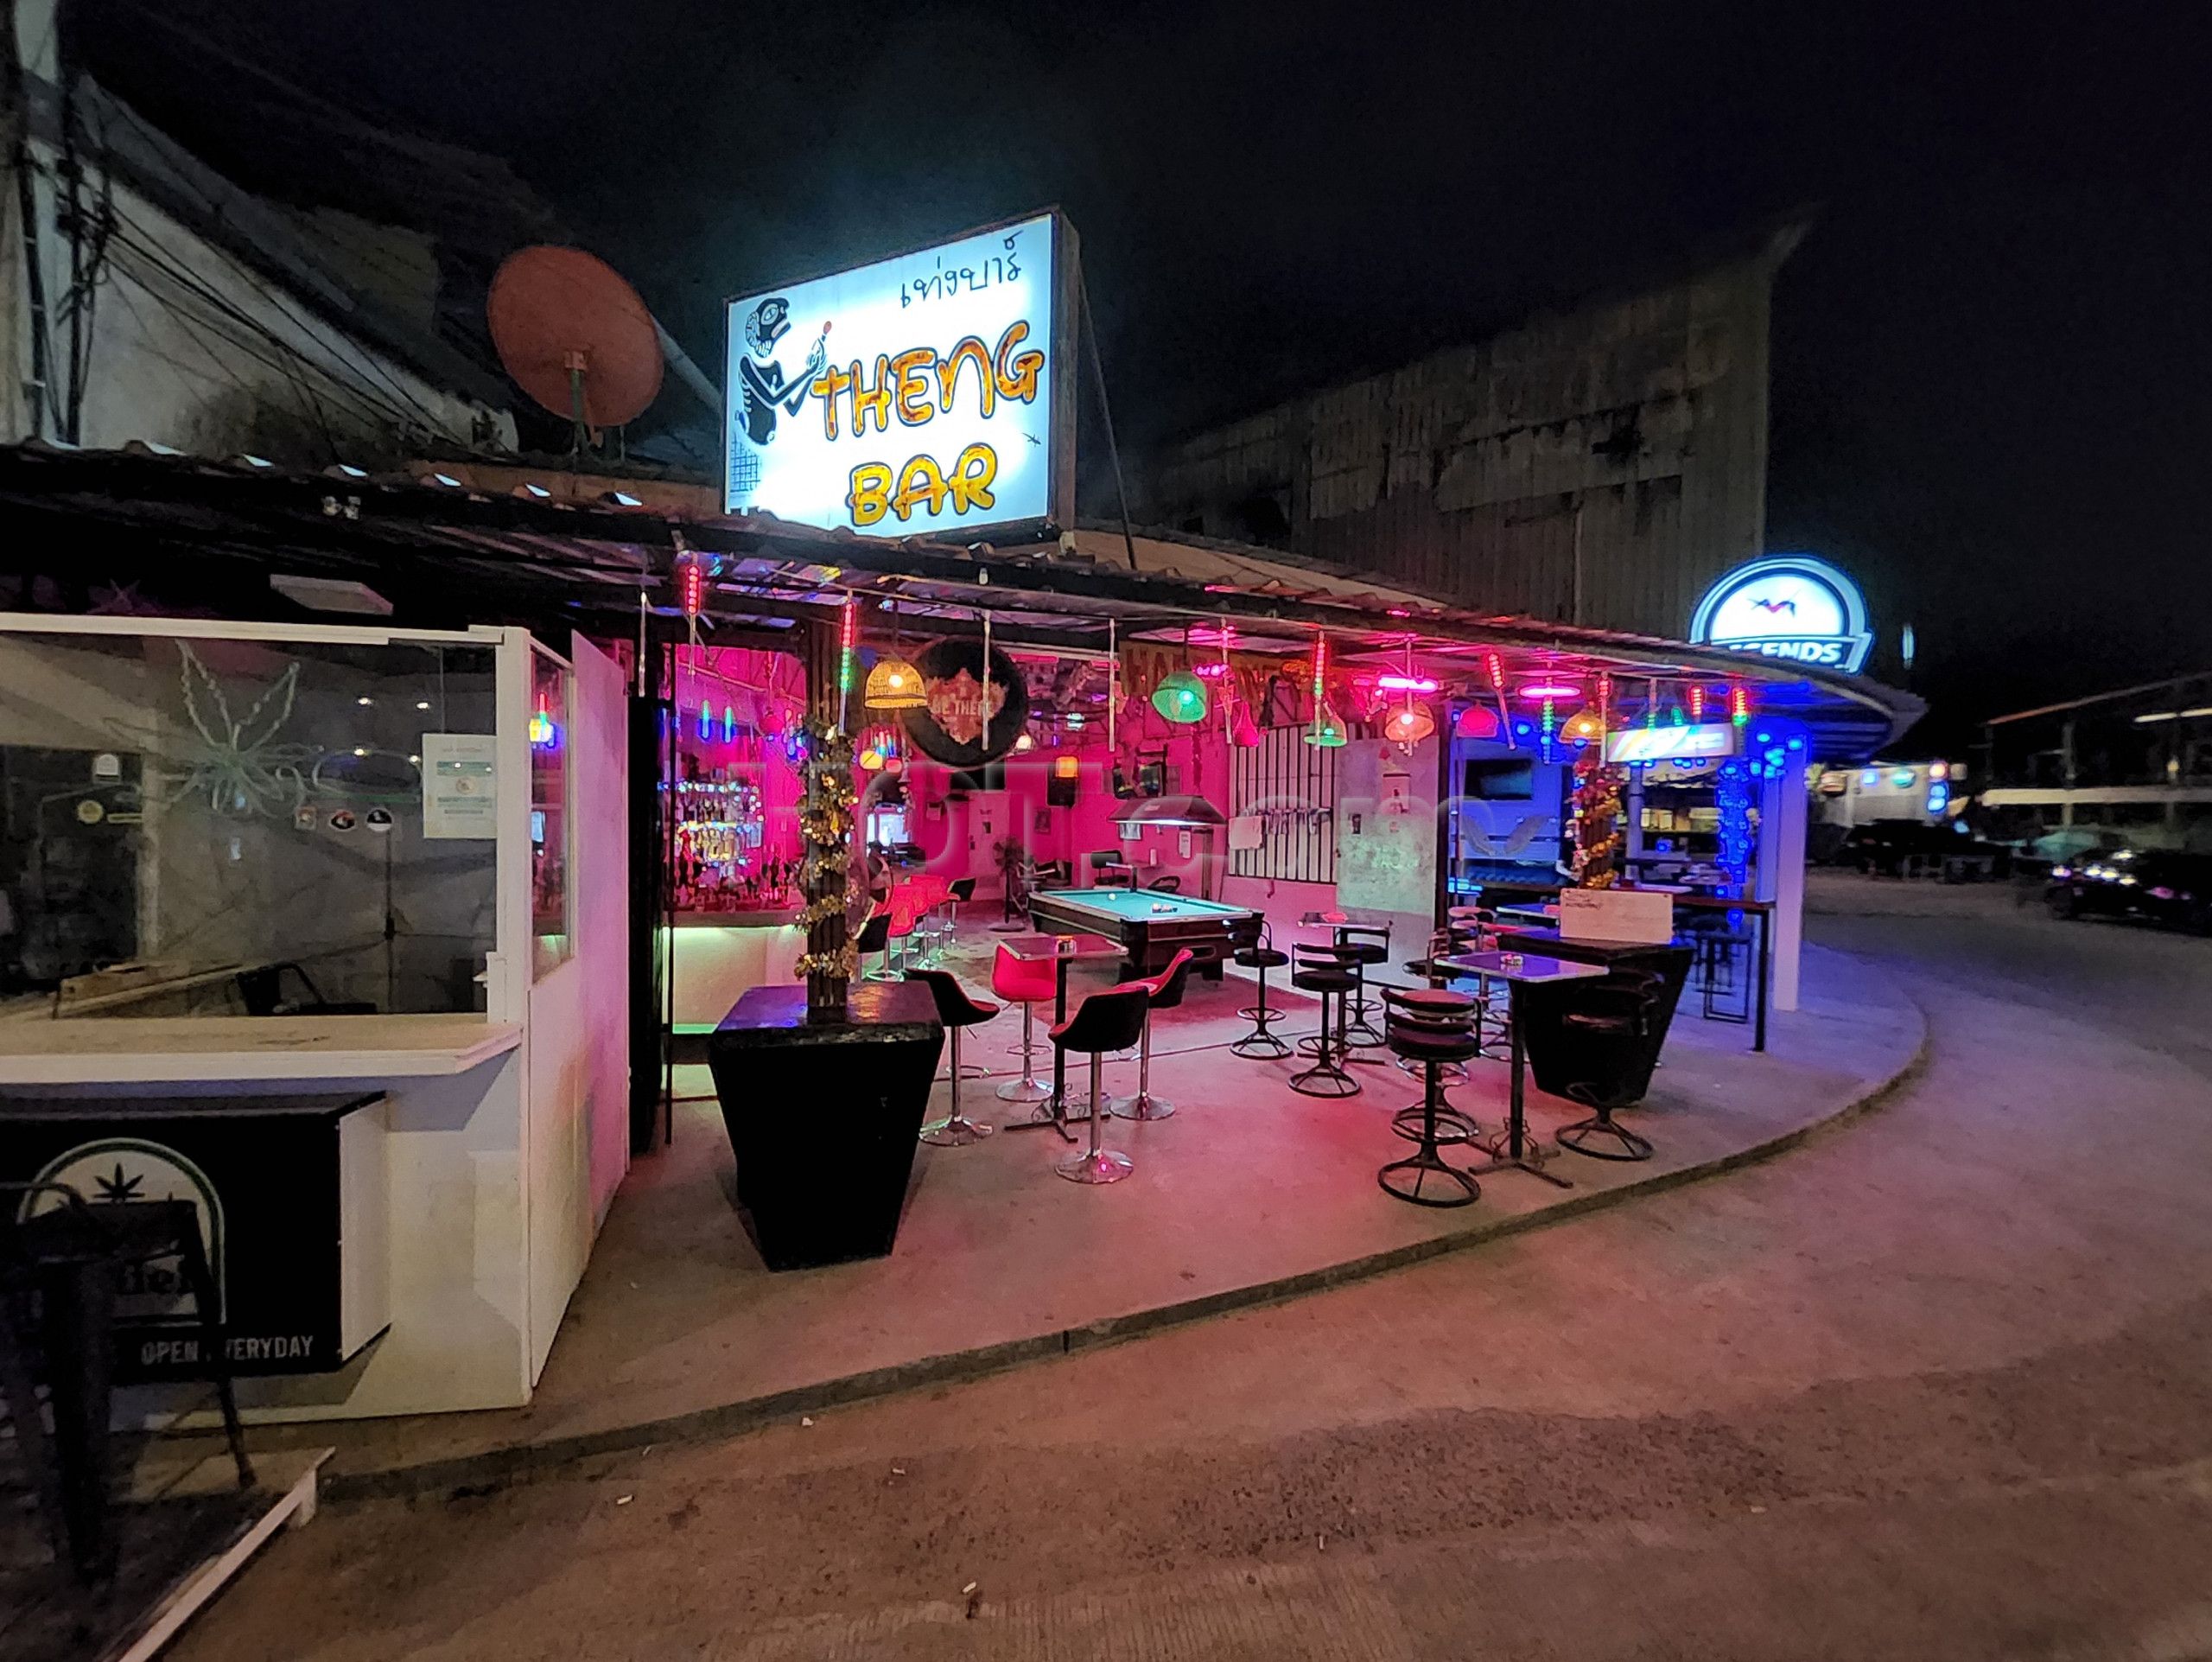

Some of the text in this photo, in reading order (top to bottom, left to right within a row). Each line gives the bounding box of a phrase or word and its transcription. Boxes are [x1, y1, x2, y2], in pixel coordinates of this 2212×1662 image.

[845, 443, 998, 526] BAR
[1728, 642, 1842, 664] ENDS
[141, 1340, 199, 1365] OPEN
